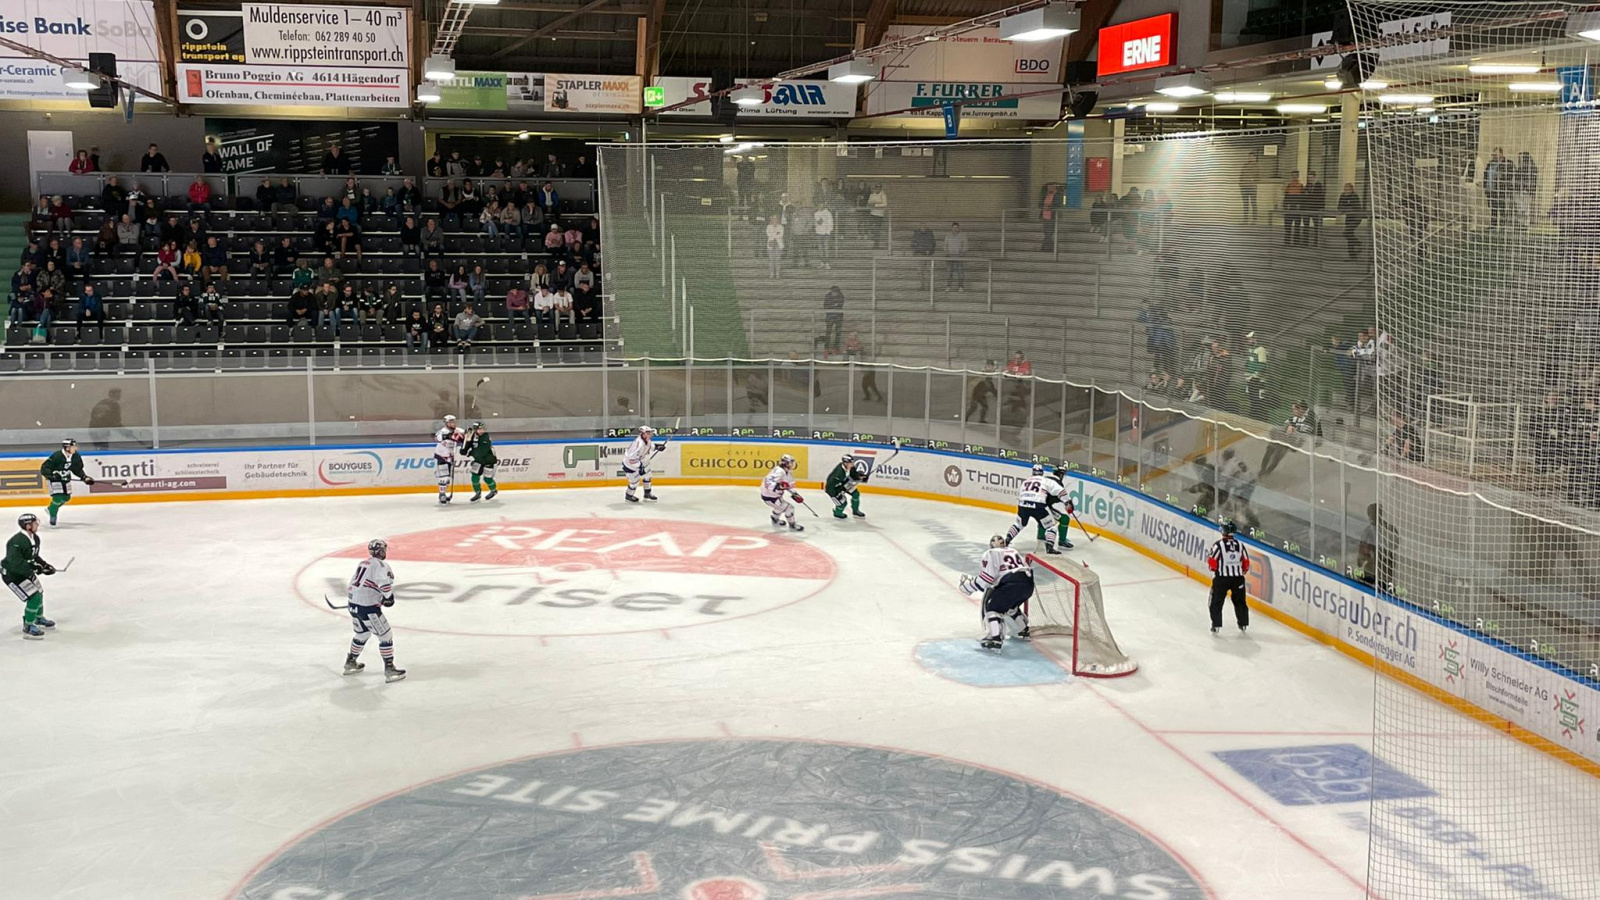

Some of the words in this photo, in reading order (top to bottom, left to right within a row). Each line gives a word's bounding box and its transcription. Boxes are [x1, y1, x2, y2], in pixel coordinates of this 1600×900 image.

[250, 7, 339, 25] Muldenservice
[366, 11, 382, 26] 40
[34, 17, 92, 36] Bank
[97, 20, 152, 38] SoBa
[278, 30, 311, 42] Telefon:
[315, 32, 331, 42] 062
[333, 32, 350, 43] 289
[352, 33, 364, 43] 40
[366, 33, 377, 43] 50
[181, 43, 227, 52] rippstein
[251, 46, 404, 64] www.rippsteintransport.ch
[1122, 35, 1161, 66] ERNE
[232, 54, 245, 63] ag
[1020, 60, 1050, 70] BDO
[205, 70, 240, 80] Bruno
[243, 71, 281, 82] Poggio
[286, 72, 304, 82] AG
[312, 72, 339, 83] 4614
[342, 73, 400, 85] Hägendorf
[206, 90, 252, 100] Ofenbau,
[326, 92, 400, 103] Plattenarbeiten
[916, 84, 928, 96] F.
[932, 84, 1003, 98] FURRER
[1570, 82, 1582, 101] A
[766, 107, 798, 115] Lüftung
[218, 143, 254, 158] WALL
[256, 139, 273, 152] OF
[102, 459, 154, 478] marti
[328, 462, 372, 470] BOUYGUES
[394, 458, 436, 470] HUG
[690, 458, 748, 469] CHICCO
[876, 464, 910, 476] Altola
[245, 470, 308, 478] Gebäudetechnik
[1069, 480, 1134, 529] dreier
[456, 525, 771, 558] REAP
[1141, 513, 1206, 560] NUSSBAUM
[1281, 568, 1418, 652] sichersauber.ch
[1356, 630, 1402, 662] Sonderegger
[1404, 655, 1416, 668] AG
[1470, 658, 1490, 677] Willy
[1491, 668, 1533, 694] Schneider
[1534, 686, 1548, 700] AG
[453, 773, 619, 812] SITE
[622, 798, 882, 855] PRIME
[900, 838, 1182, 900] SWISS
